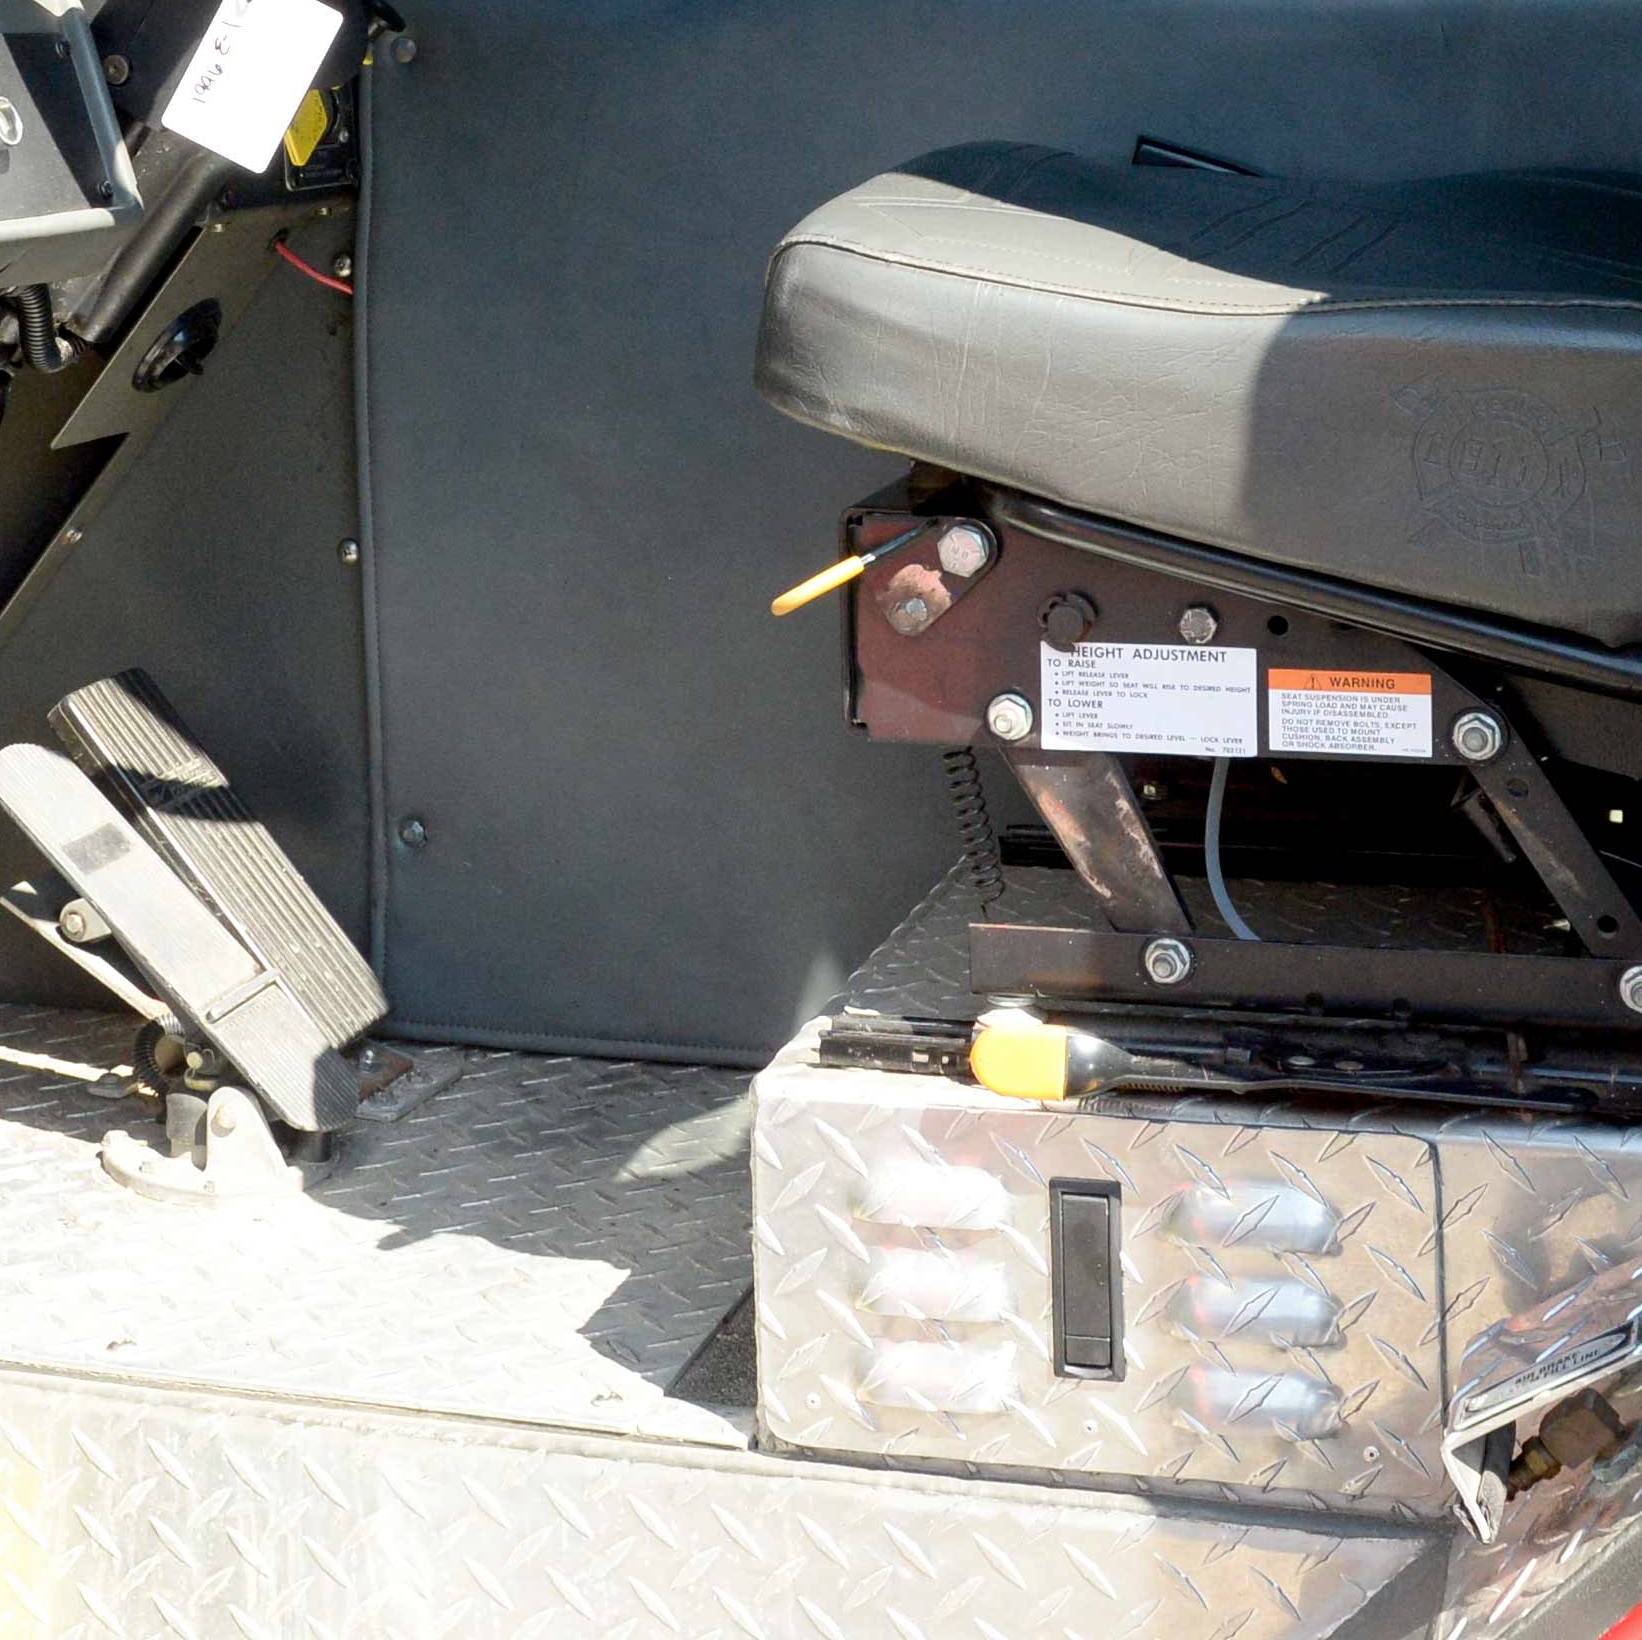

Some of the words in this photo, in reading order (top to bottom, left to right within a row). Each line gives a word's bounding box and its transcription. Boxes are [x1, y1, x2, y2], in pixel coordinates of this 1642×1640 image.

[192, 63, 224, 104] 1996
[1070, 645, 1124, 660] HEIGHT
[1132, 648, 1227, 663] ADJUSTMENT
[1047, 658, 1061, 667] TO
[1068, 659, 1096, 669] RAISE
[1078, 671, 1105, 679] RELEASE
[1329, 676, 1396, 690] WARNING
[1062, 689, 1089, 697] RELEASE
[1193, 685, 1221, 693] DESIRED
[1225, 686, 1251, 694] HEIGHT
[1047, 698, 1061, 708] TO
[1068, 699, 1103, 709] LOWER
[1281, 692, 1302, 700] SEAT
[1305, 693, 1358, 703] SUSPENSION
[1360, 695, 1369, 703] IS
[1371, 696, 1401, 704] UNDER
[1281, 700, 1313, 709] SPRING
[1315, 701, 1338, 709] LOAD
[1340, 702, 1358, 710] AND
[1359, 703, 1377, 711] MAY
[1379, 704, 1408, 712] CAUSE
[1282, 708, 1312, 716] INJURY
[1297, 718, 1313, 726] NOT
[1316, 719, 1350, 727] REMOVE
[1384, 722, 1417, 730] EXCEPT
[1282, 726, 1308, 734] THOSE
[1312, 727, 1334, 735] USED
[1351, 728, 1381, 736] MOUNT
[1297, 742, 1326, 750] SHOCK
[1351, 736, 1397, 745] ASSEMBLY
